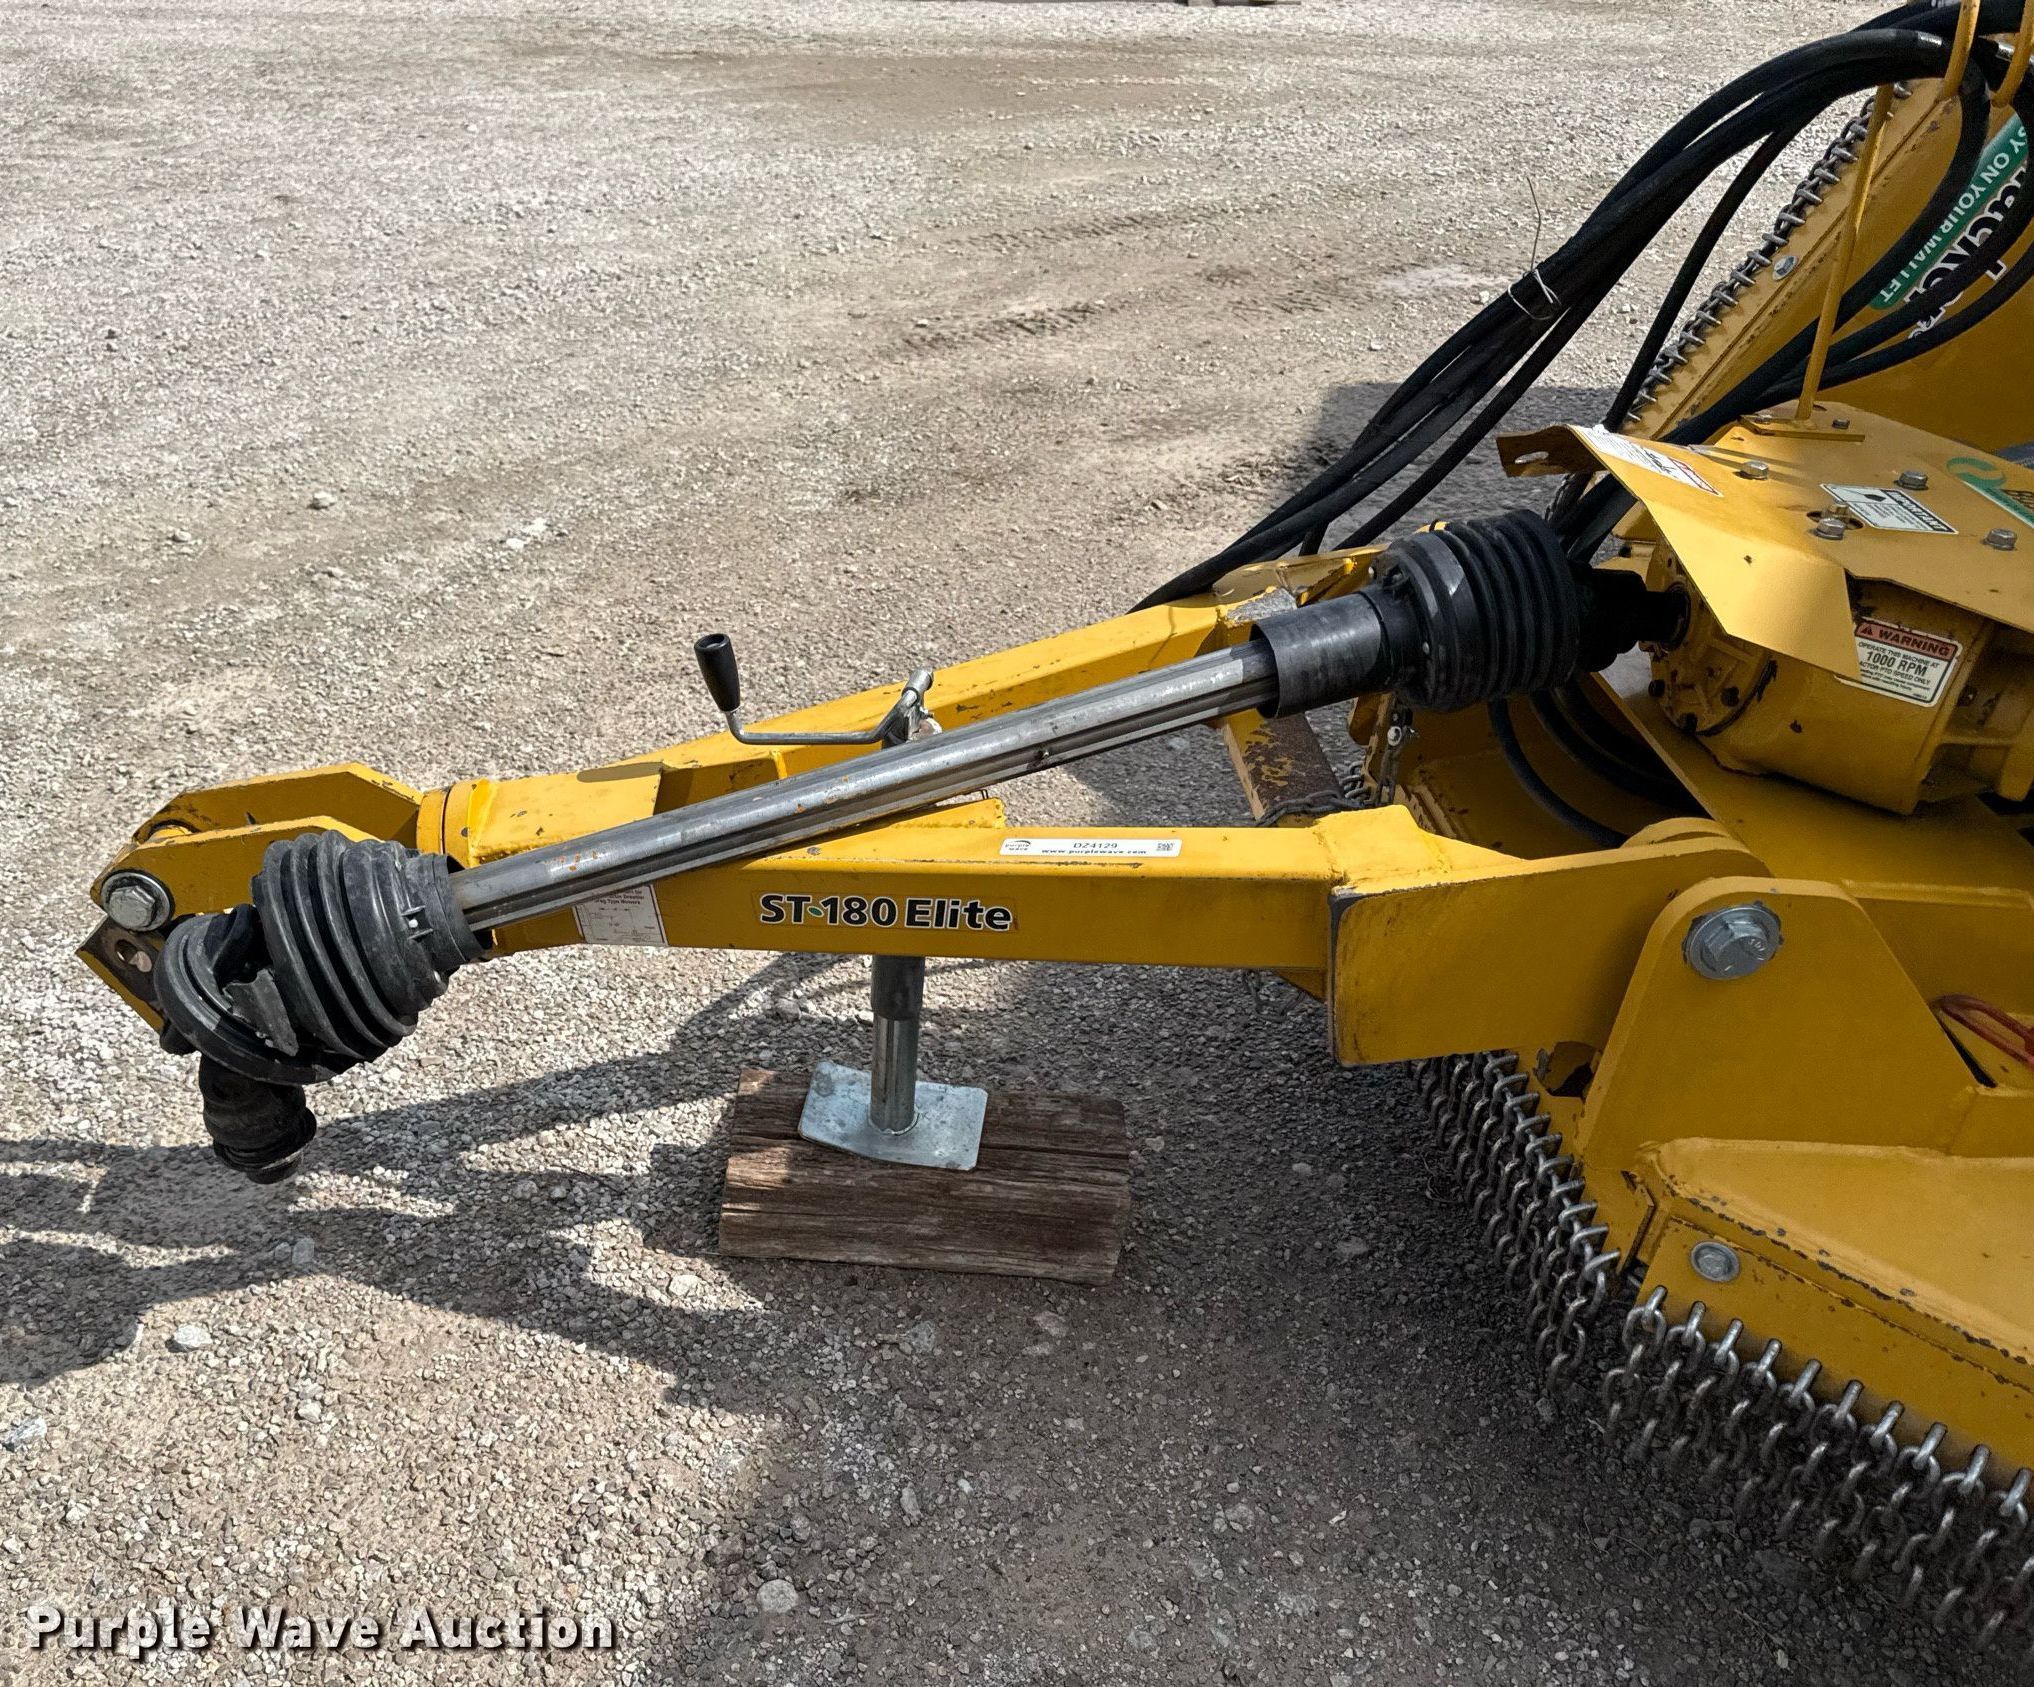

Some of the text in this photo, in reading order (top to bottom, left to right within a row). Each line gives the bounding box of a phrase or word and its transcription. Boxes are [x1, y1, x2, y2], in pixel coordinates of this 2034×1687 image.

[1980, 152, 2010, 184] ON
[1858, 641, 1886, 654] OPERATE
[1902, 653, 1931, 666] MACHINE
[1879, 629, 1949, 657] WARNING
[1859, 661, 1879, 671] ACTOR
[1893, 670, 1914, 681] SPEED
[1866, 651, 1928, 677] 1000 RPM
[905, 897, 1013, 931] Elite
